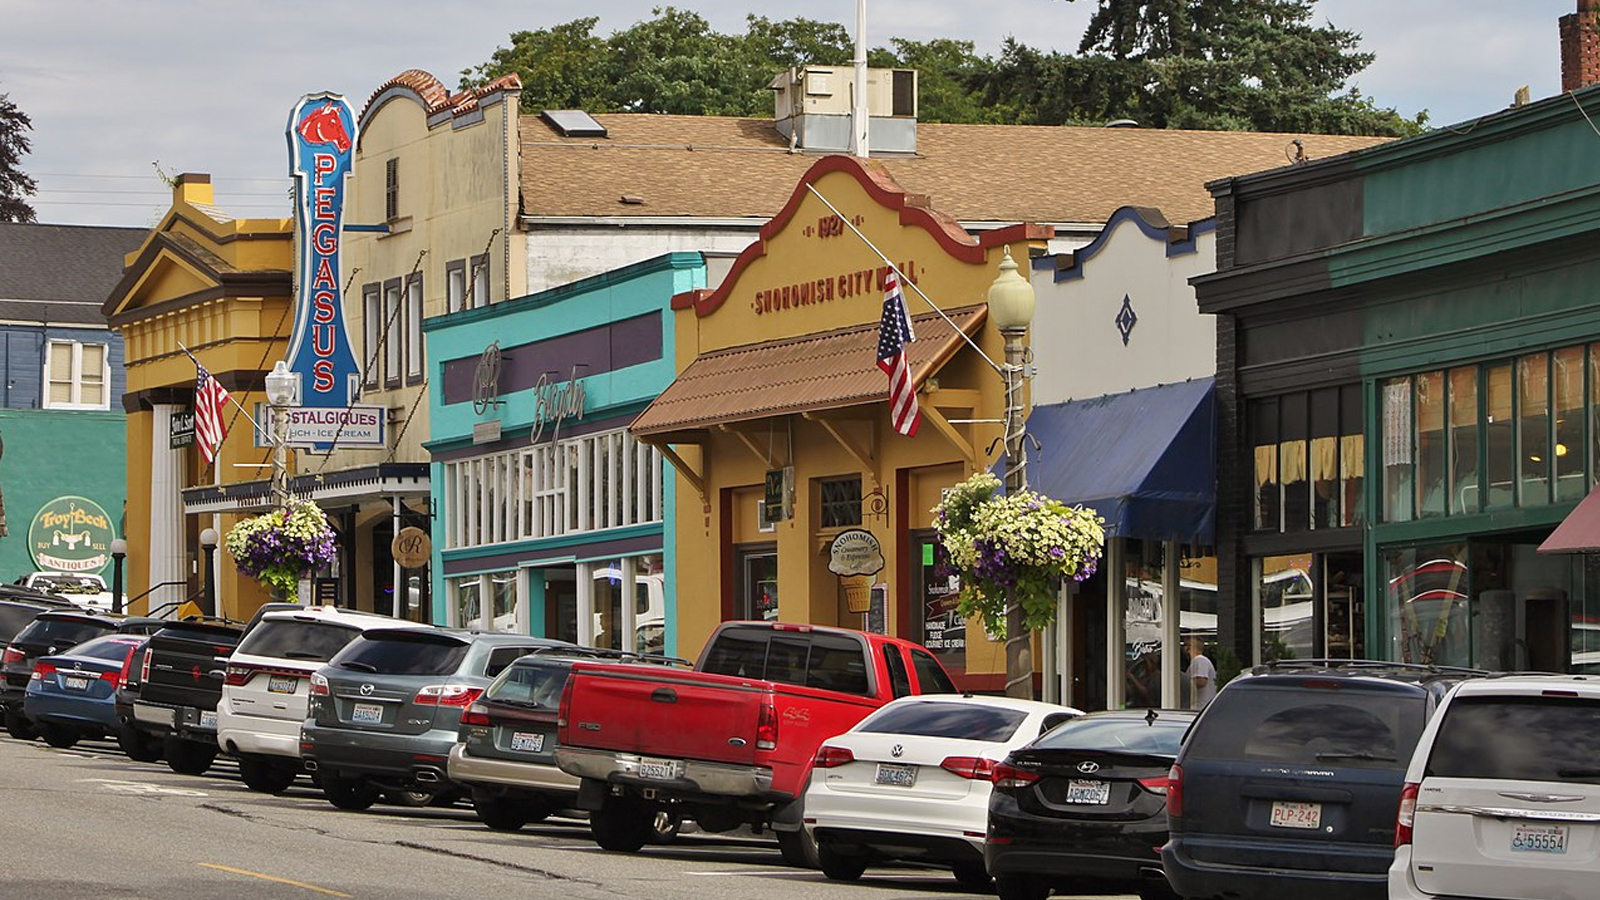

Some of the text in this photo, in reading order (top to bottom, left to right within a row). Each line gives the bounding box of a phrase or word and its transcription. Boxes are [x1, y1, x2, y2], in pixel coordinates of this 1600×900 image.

[818, 214, 845, 239] 1921
[313, 152, 337, 393] PEGASUS
[755, 260, 918, 314] SNOHOMISH CITY HLL
[271, 411, 377, 426] STALGIQUES
[317, 429, 333, 437] ICE
[40, 508, 108, 529] Troy Beck
[37, 541, 106, 550] BUY SELL
[833, 532, 879, 554] SNOHOMISH
[48, 558, 98, 570] ANTIQUES
[1273, 808, 1318, 823] PLP-242
[1527, 833, 1564, 850] 55554
